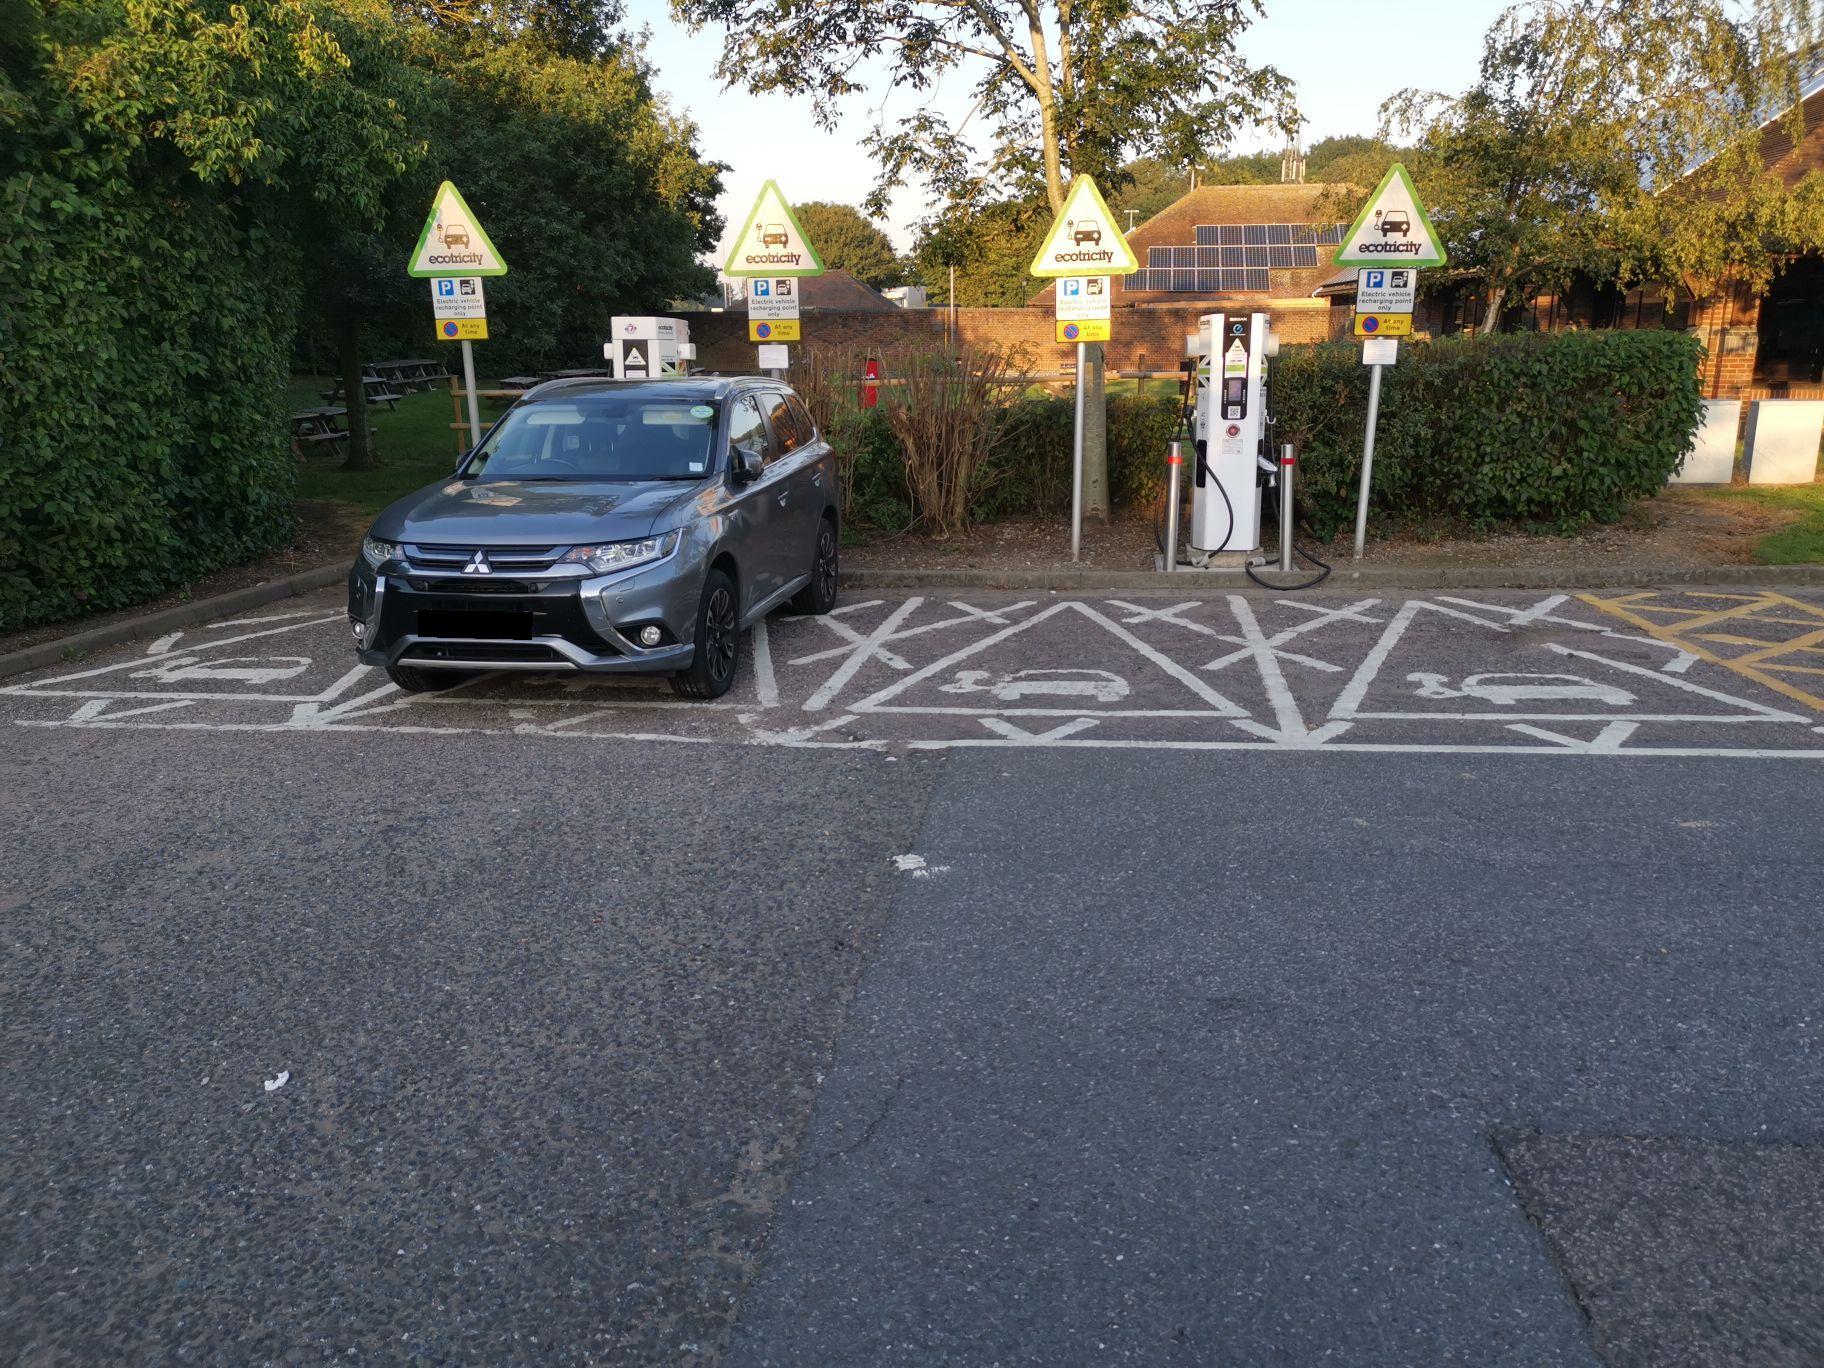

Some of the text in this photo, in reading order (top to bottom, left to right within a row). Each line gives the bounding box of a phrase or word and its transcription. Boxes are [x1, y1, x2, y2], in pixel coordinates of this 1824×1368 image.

[1359, 240, 1422, 255] ecotricity
[429, 252, 483, 265] ecotricity
[746, 252, 801, 265] ecotricity
[1055, 249, 1114, 263] ecotricity
[782, 304, 797, 312] point
